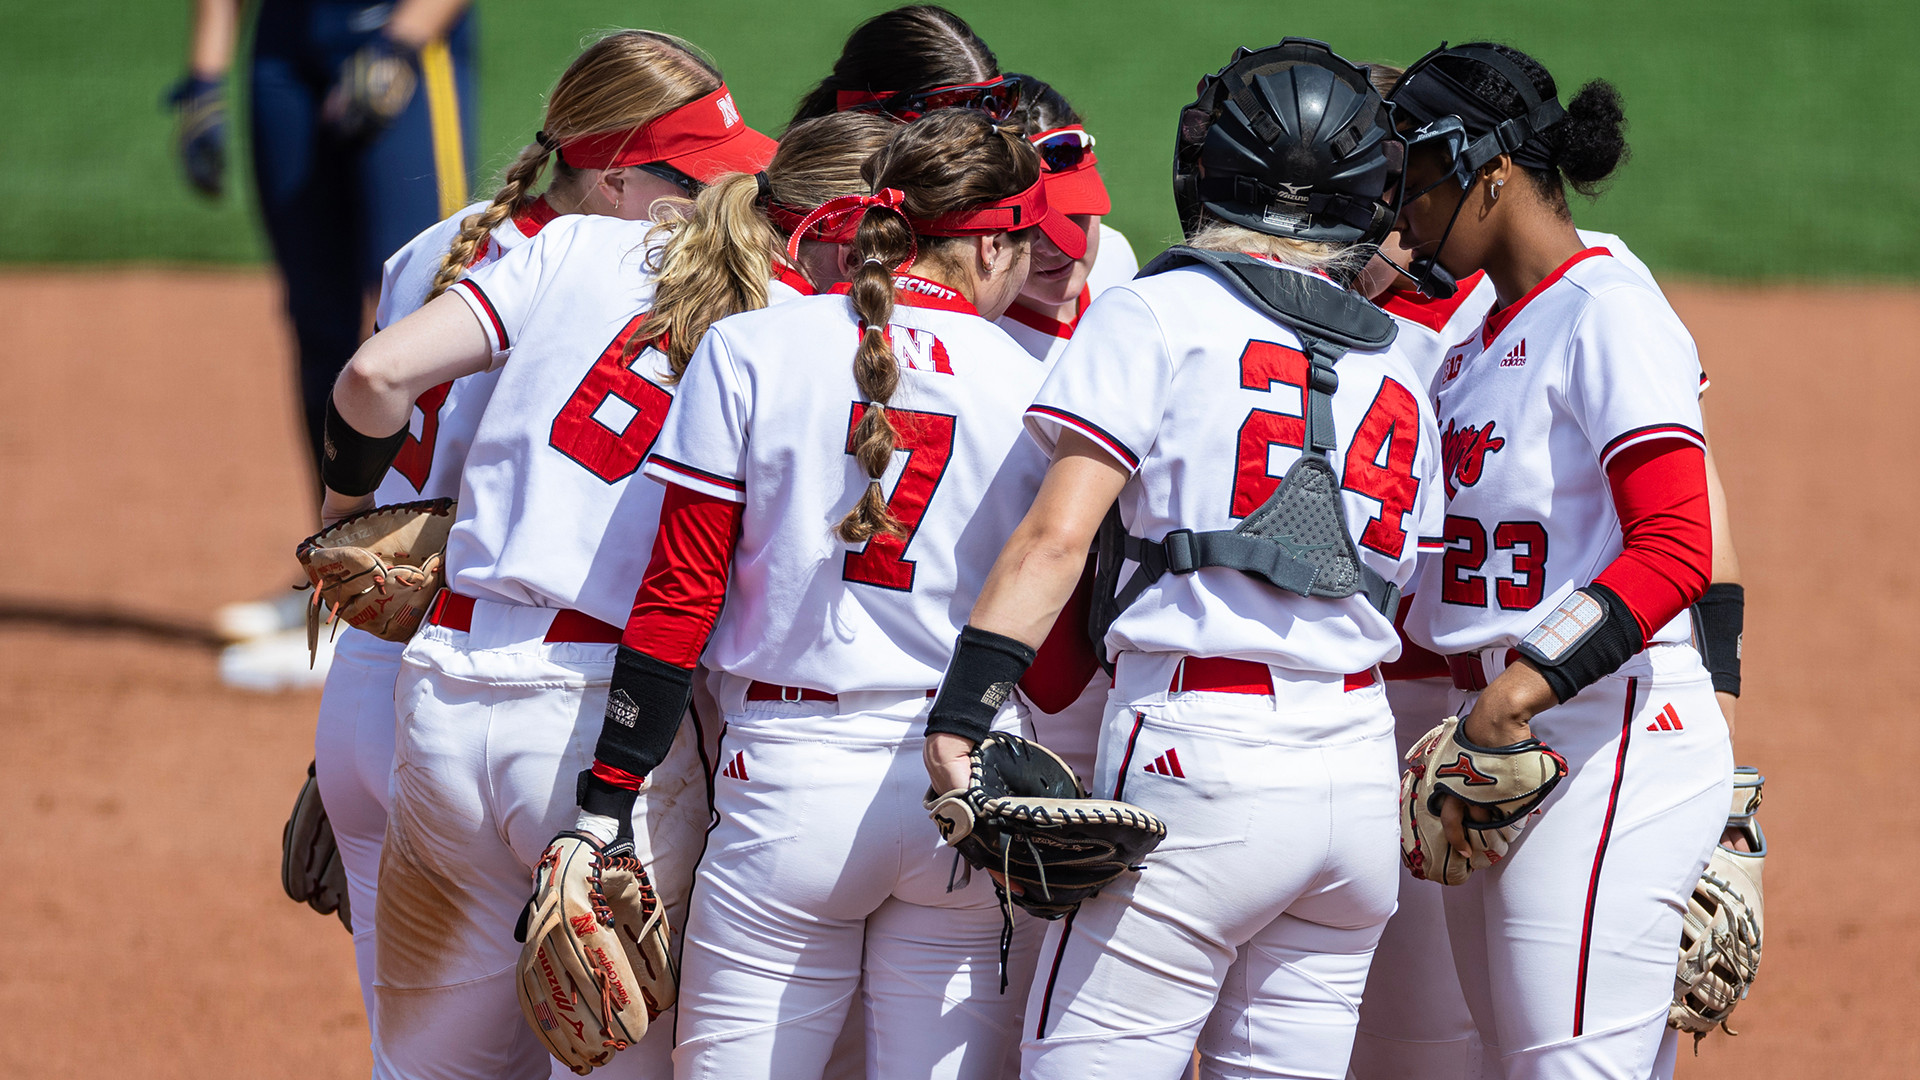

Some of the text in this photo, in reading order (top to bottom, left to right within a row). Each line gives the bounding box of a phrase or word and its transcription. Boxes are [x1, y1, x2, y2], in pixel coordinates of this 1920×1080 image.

[716, 92, 740, 129] N
[889, 323, 936, 372] N
[1499, 355, 1526, 367] adidas
[548, 311, 674, 486] 6
[1229, 338, 1421, 562] 24
[842, 400, 957, 593] 7
[1441, 514, 1548, 611] 23
[570, 911, 599, 939] N
